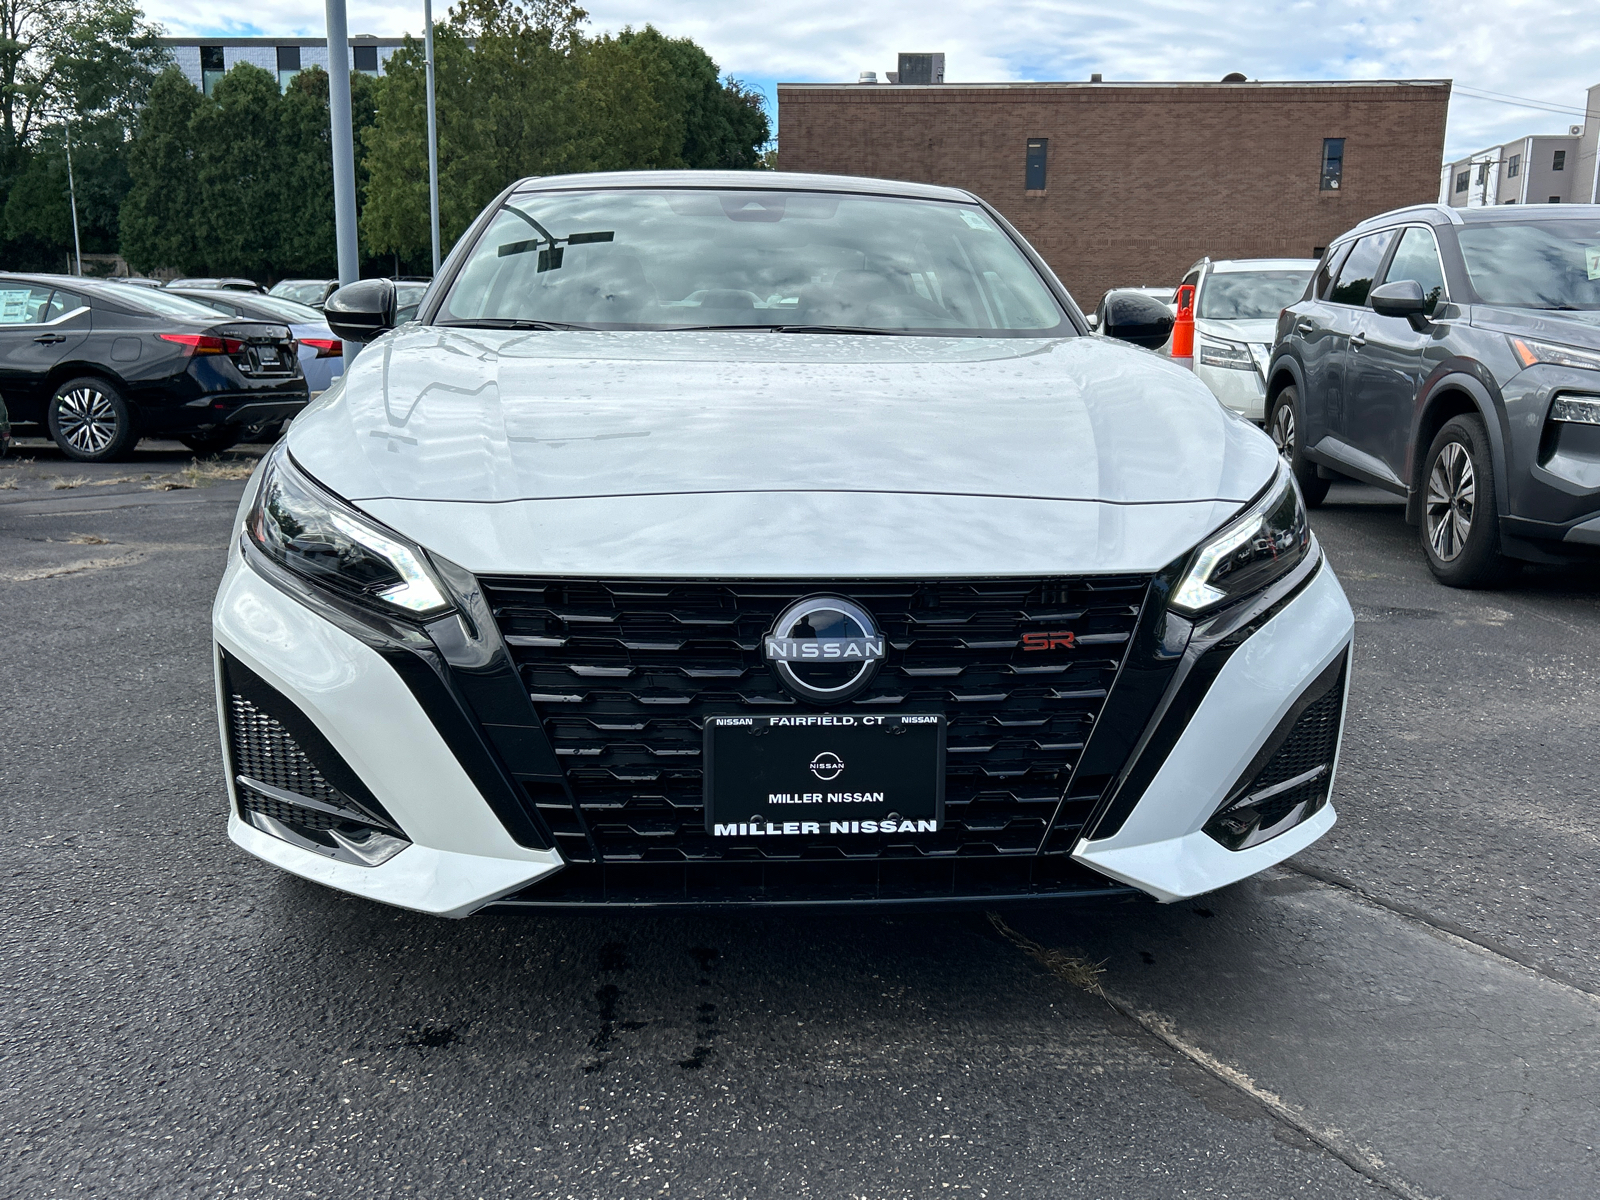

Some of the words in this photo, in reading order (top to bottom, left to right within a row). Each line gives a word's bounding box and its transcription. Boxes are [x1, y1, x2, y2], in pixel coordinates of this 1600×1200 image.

[1022, 631, 1075, 651] SR
[769, 641, 883, 658] NISSAN
[716, 718, 753, 726] NISSAN
[770, 717, 859, 726] FAIRFIELD,
[862, 716, 885, 726] CT
[901, 716, 938, 725] NISSAN
[768, 793, 823, 804] MILLER
[827, 792, 884, 803] NISSAN
[714, 823, 820, 836] MILLER
[830, 820, 937, 834] NISSAN
